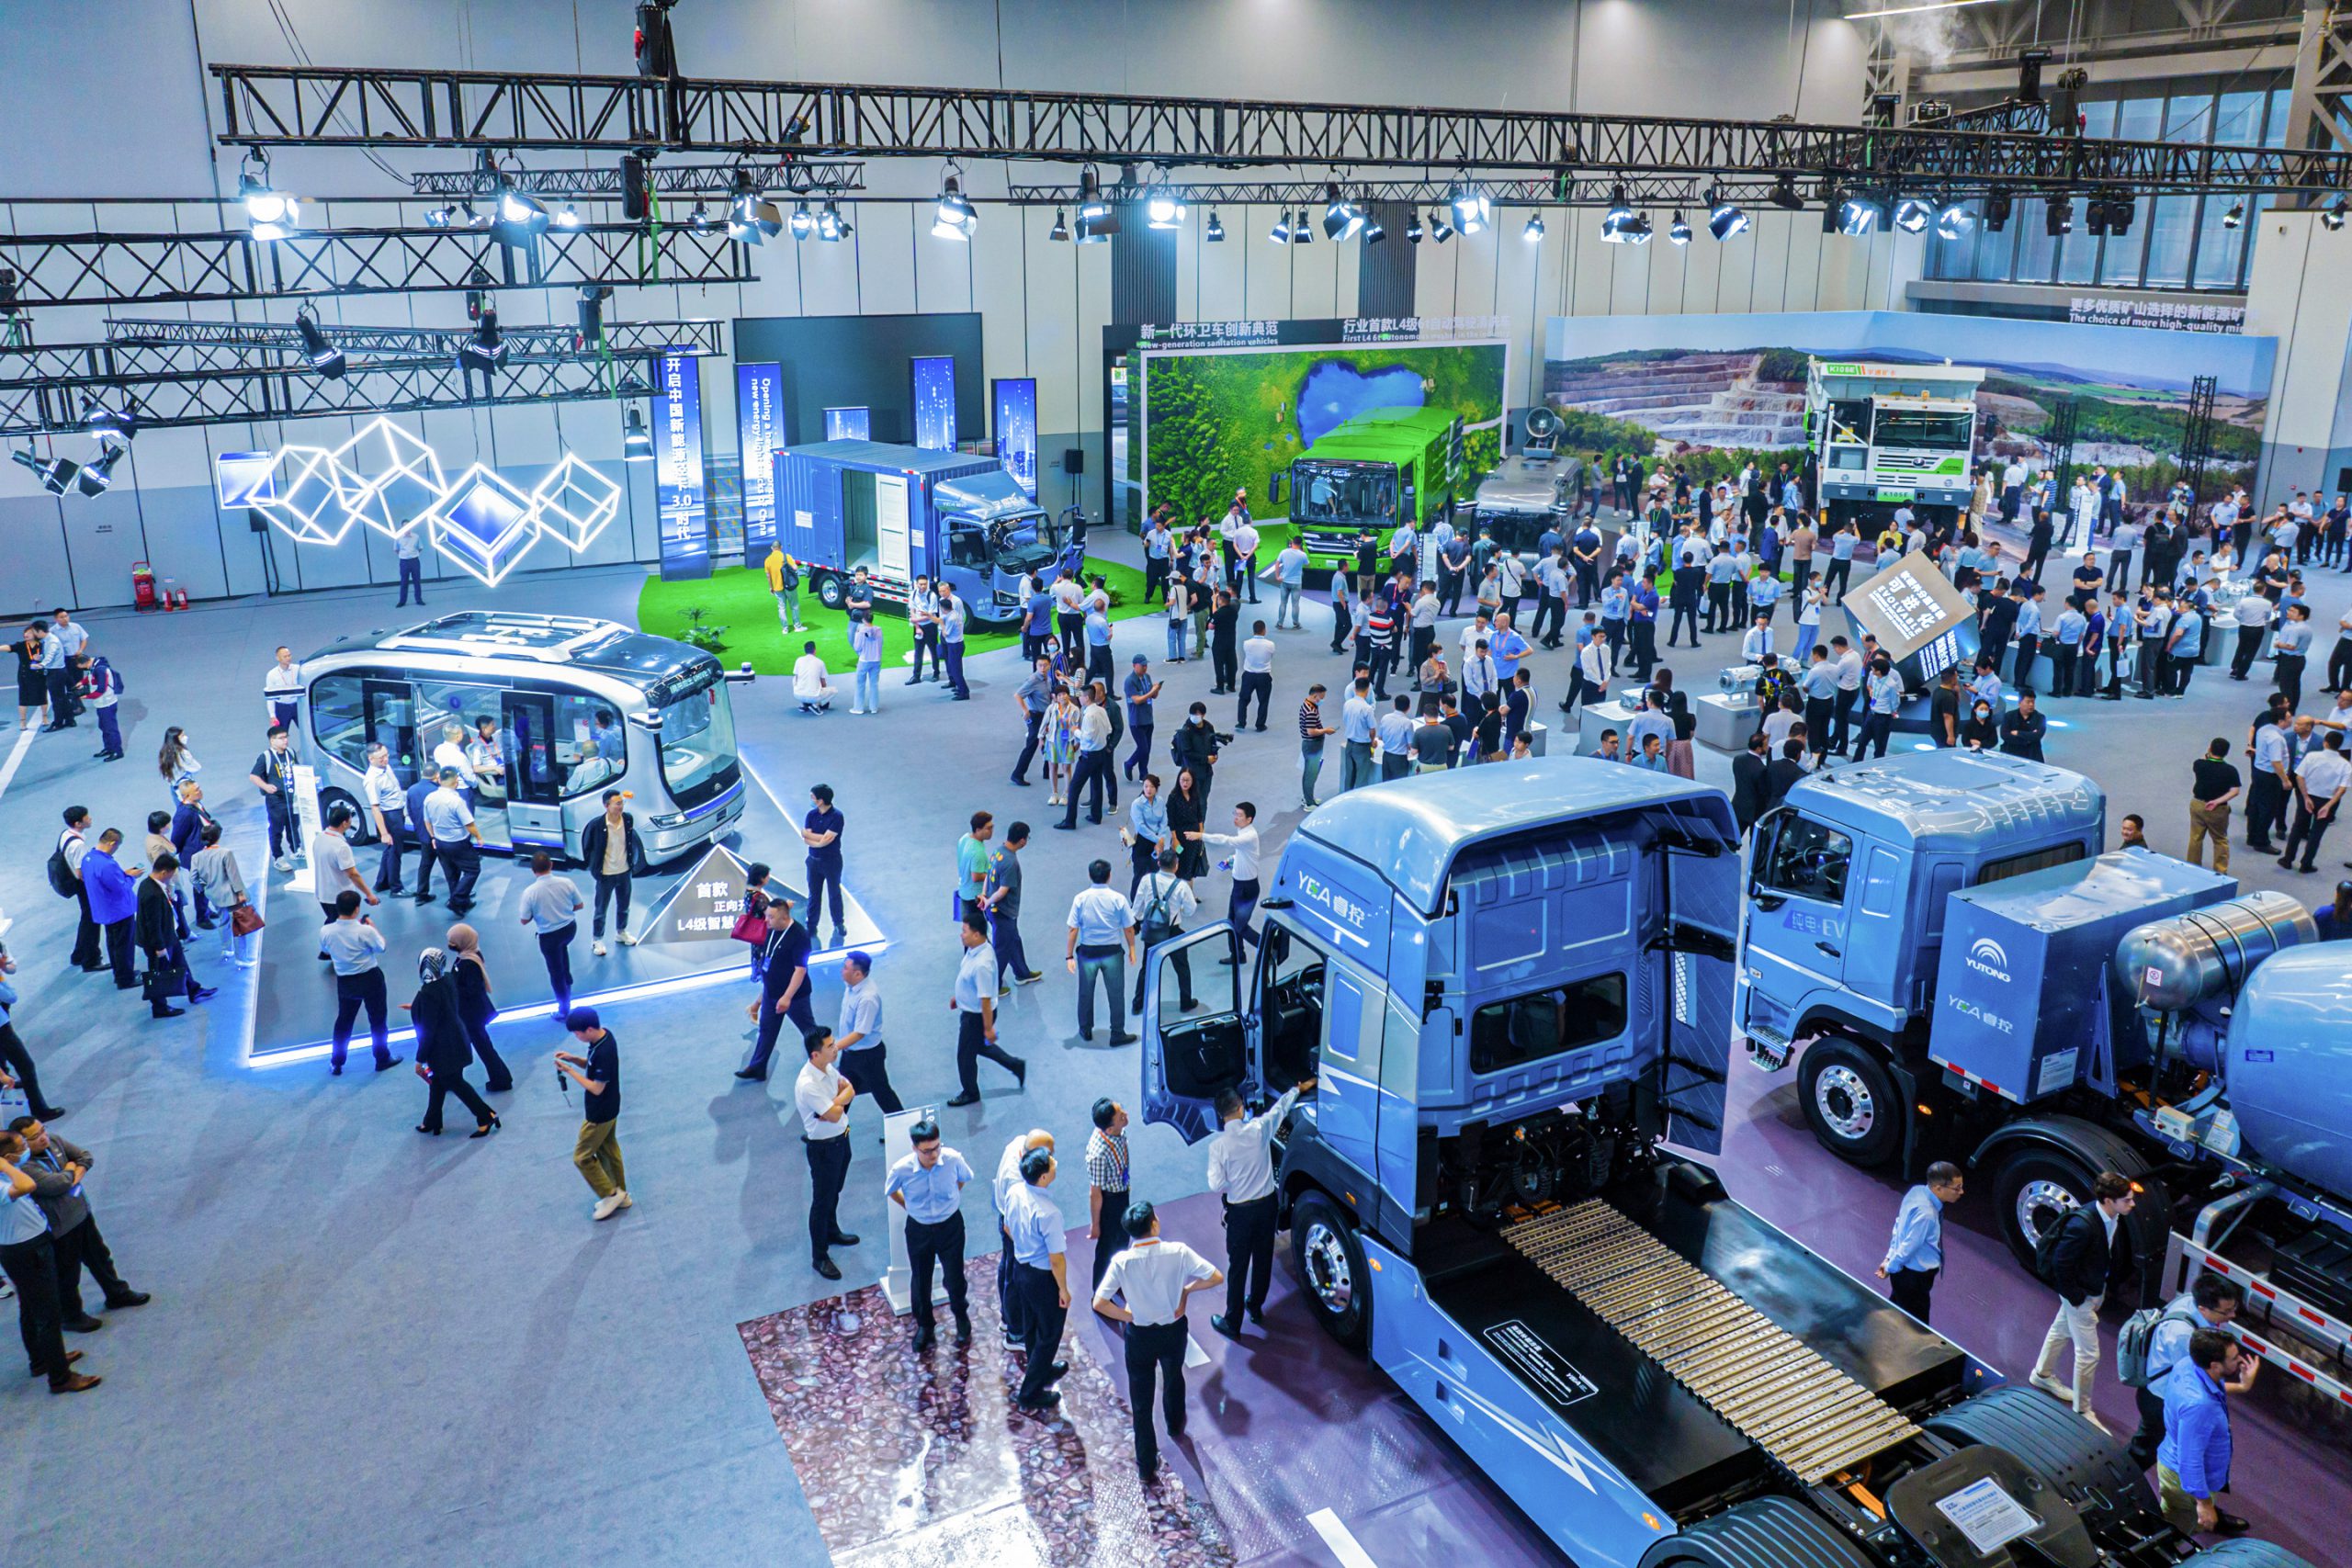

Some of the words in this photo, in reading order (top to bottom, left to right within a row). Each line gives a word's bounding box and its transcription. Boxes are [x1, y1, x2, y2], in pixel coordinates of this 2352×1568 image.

[1140, 321, 1279, 340] 新一代环卫车创新典范
[2069, 312, 2086, 323] The
[2087, 314, 2118, 325] choice
[2120, 315, 2132, 325] of
[2132, 319, 2158, 329] more
[2159, 317, 2224, 333] high-quality
[1206, 338, 1246, 347] sanitation
[1247, 337, 1279, 346] vehicles
[1343, 333, 1362, 343] First
[1363, 333, 1372, 342] L4
[751, 378, 760, 400] new
[762, 378, 773, 421] Opening
[752, 400, 762, 437] energy
[763, 422, 772, 430] a
[672, 494, 692, 507] 3.0
[675, 511, 692, 541] 时代
[758, 506, 768, 536] China
[1877, 585, 1924, 636] EVOLVABLE
[696, 881, 729, 899] 首款
[677, 915, 740, 931] L4级智慧
[1965, 956, 2012, 983] YUTONG
